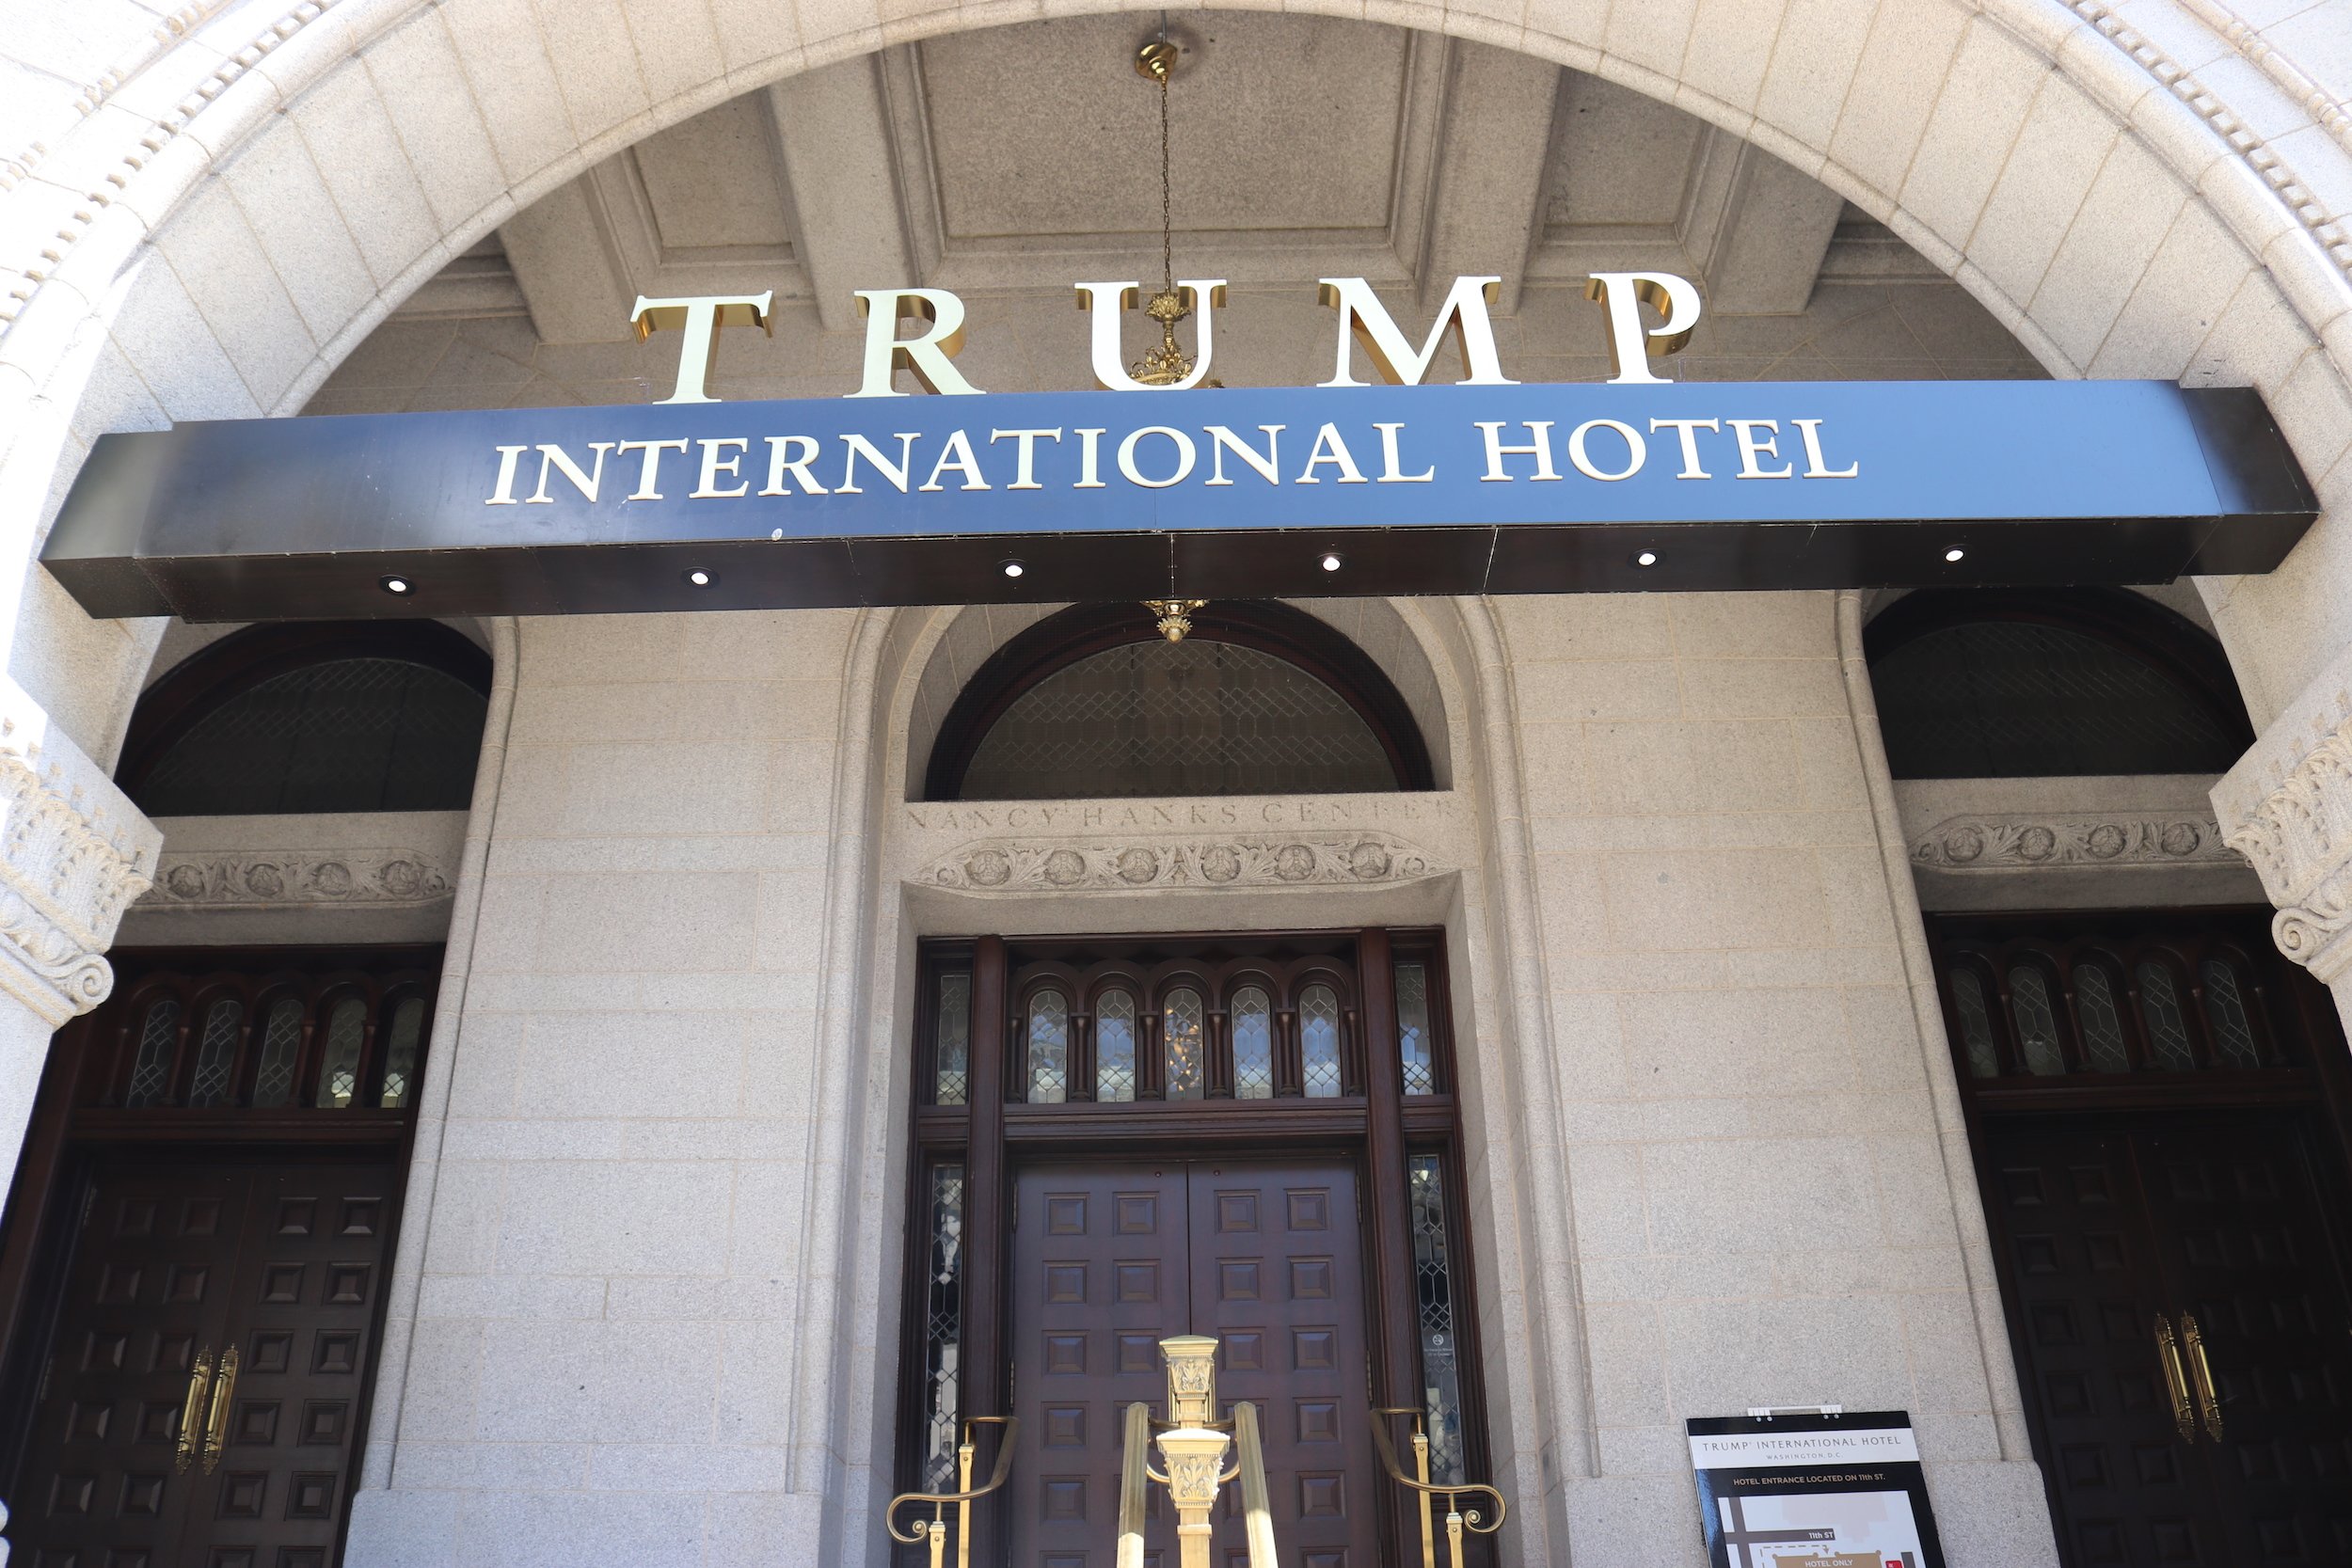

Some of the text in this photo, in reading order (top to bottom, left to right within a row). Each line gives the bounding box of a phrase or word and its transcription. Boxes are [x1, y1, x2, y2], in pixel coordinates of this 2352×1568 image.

[628, 272, 1703, 405] TRUMP
[485, 419, 1859, 505] INTERNATIONAL HOTEL
[906, 807, 1058, 829] NANCY
[1084, 802, 1237, 826] HANKS
[1703, 1435, 1901, 1451] TRUMP INTERNATIONAL HOTEL
[1733, 1478, 1760, 1486] HOTEL
[1761, 1476, 1805, 1485] ENTRANCE
[1806, 1475, 1843, 1483] LOCATED
[1858, 1473, 1873, 1481] 11th
[1824, 1530, 1834, 1539] ST
[1804, 1559, 1853, 1568] HOTEL ONLY
